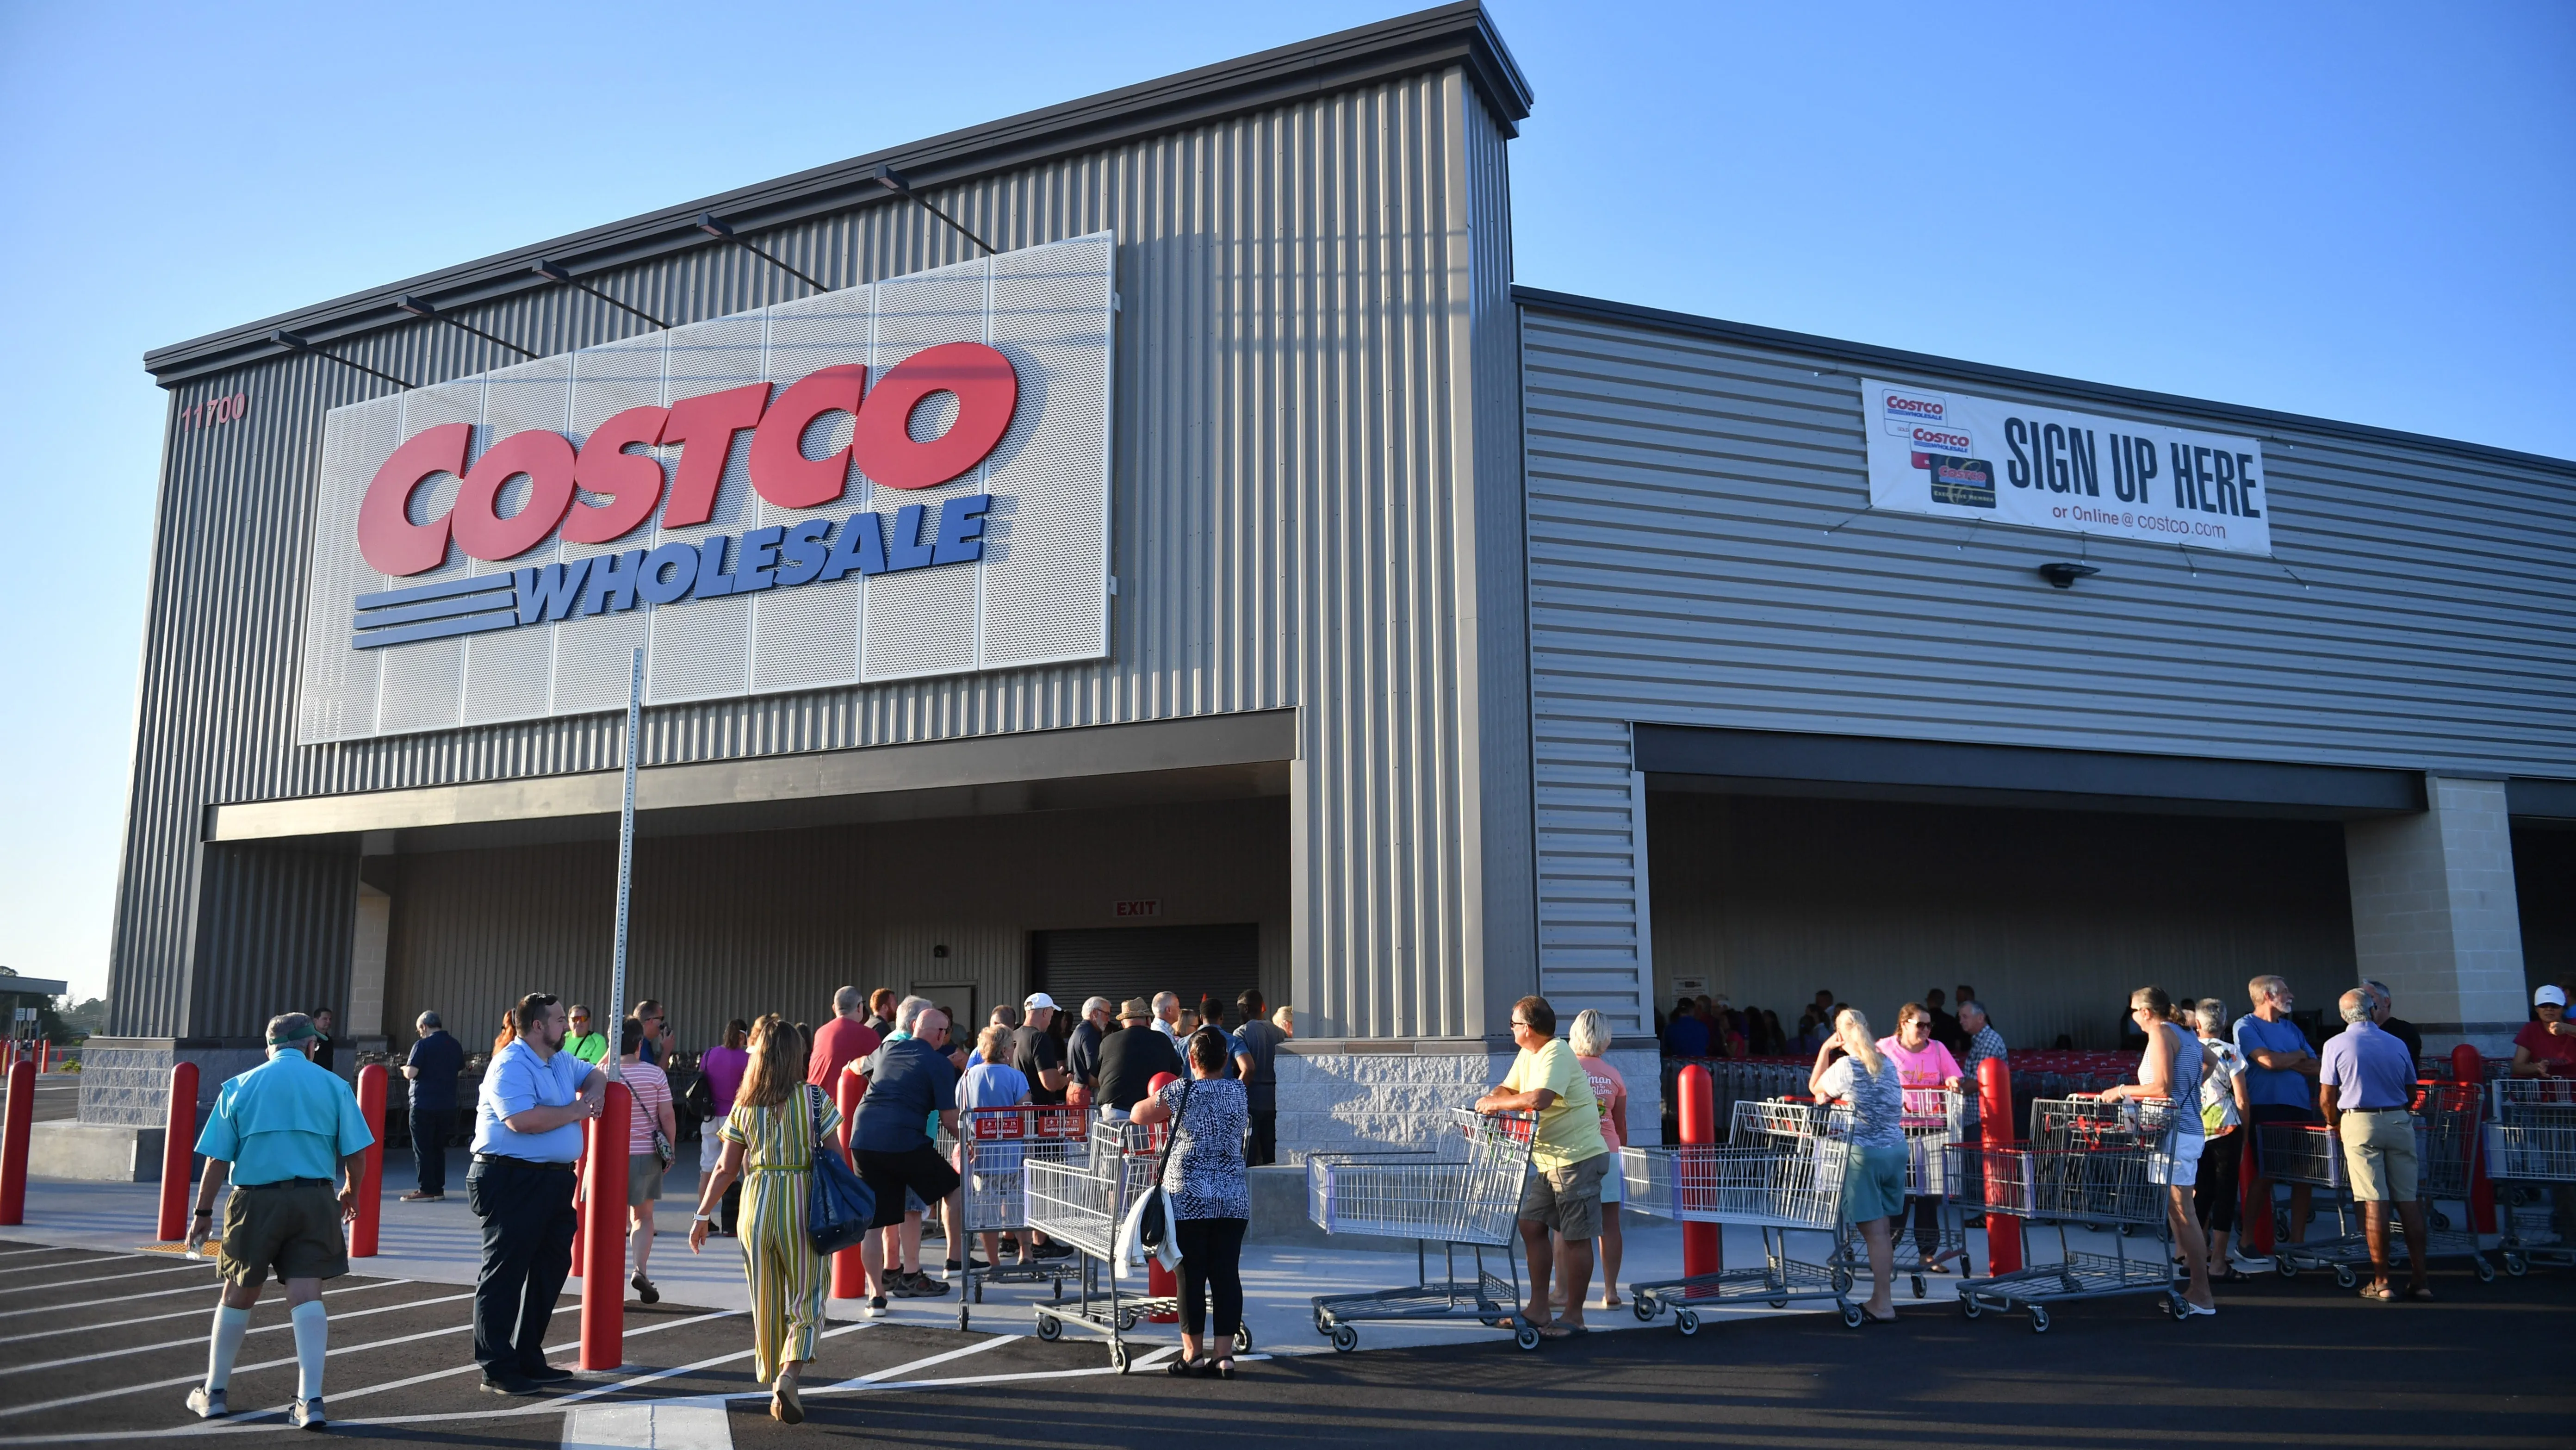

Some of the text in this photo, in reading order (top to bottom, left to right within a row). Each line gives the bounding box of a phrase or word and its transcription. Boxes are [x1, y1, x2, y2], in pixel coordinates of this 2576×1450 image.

[182, 392, 246, 432] 11700
[1887, 396, 1943, 414] COSTCO
[1906, 411, 1943, 420] WHOLESALE
[1913, 428, 1970, 447] COSTCO
[1931, 443, 1968, 453] WHOLESALE
[357, 341, 1018, 577] COSTCO
[2005, 417, 2261, 519] SIGN UP HERE
[1938, 465, 1987, 482] COSTCO
[2053, 506, 2226, 539] or Online @ costco.com
[514, 493, 993, 625] WHOLESALE
[1117, 901, 1157, 916] EXIT
